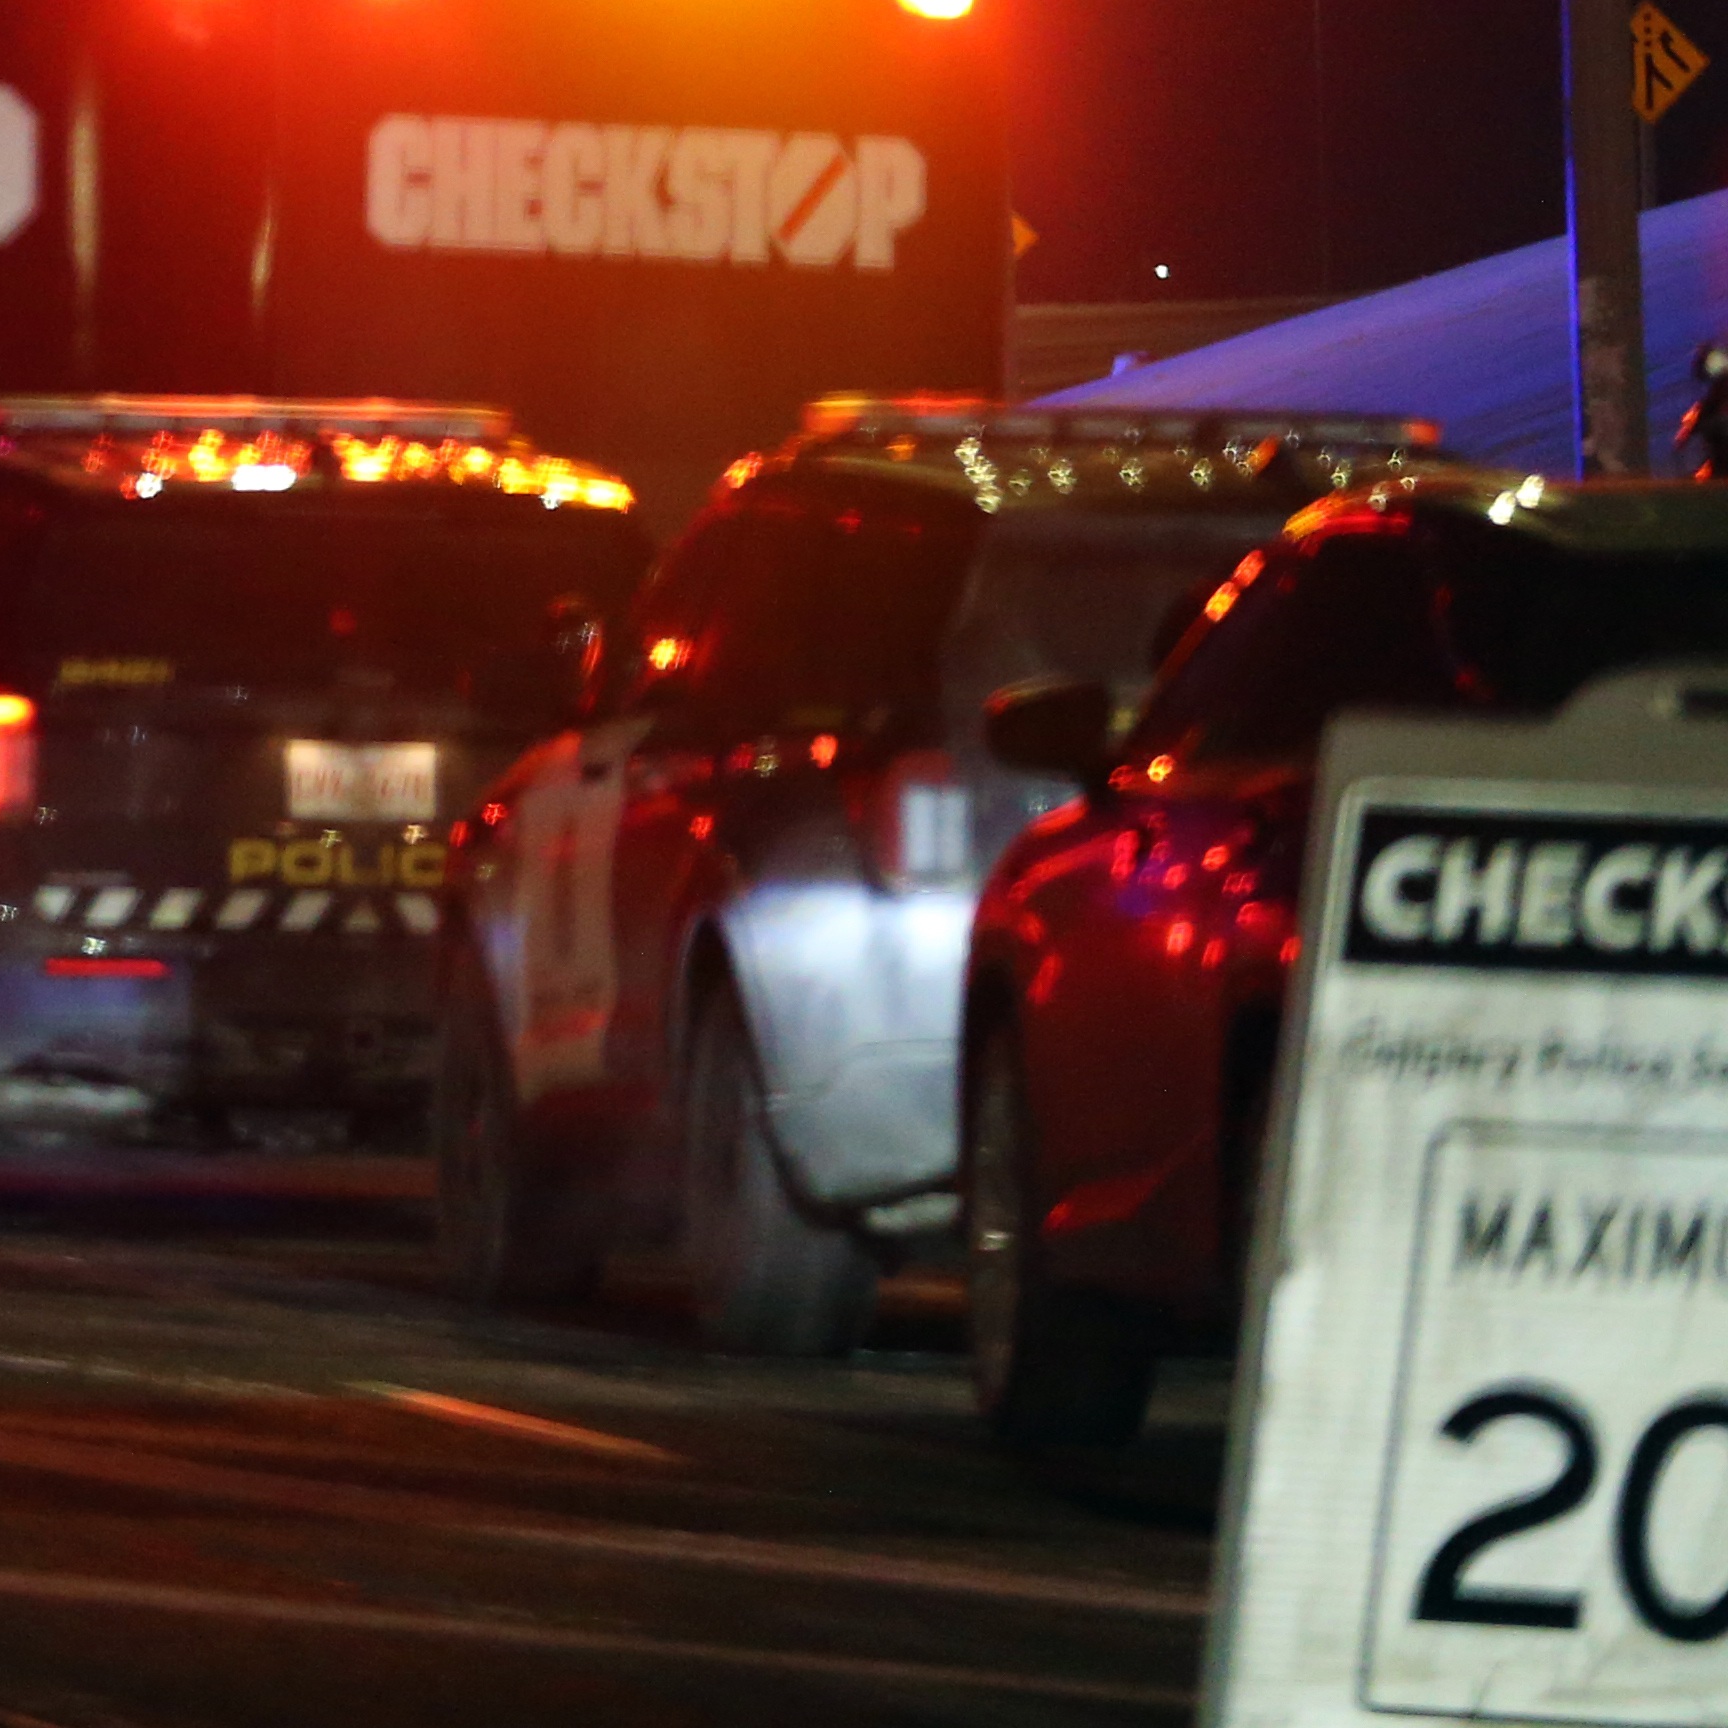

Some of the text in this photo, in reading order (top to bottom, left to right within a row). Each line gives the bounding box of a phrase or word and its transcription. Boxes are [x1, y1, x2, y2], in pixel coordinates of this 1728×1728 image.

[365, 111, 928, 273] CHECKSTOP
[229, 837, 446, 887] POLIC
[1361, 832, 1728, 956] CHECK
[1411, 1376, 1728, 1642] 20
